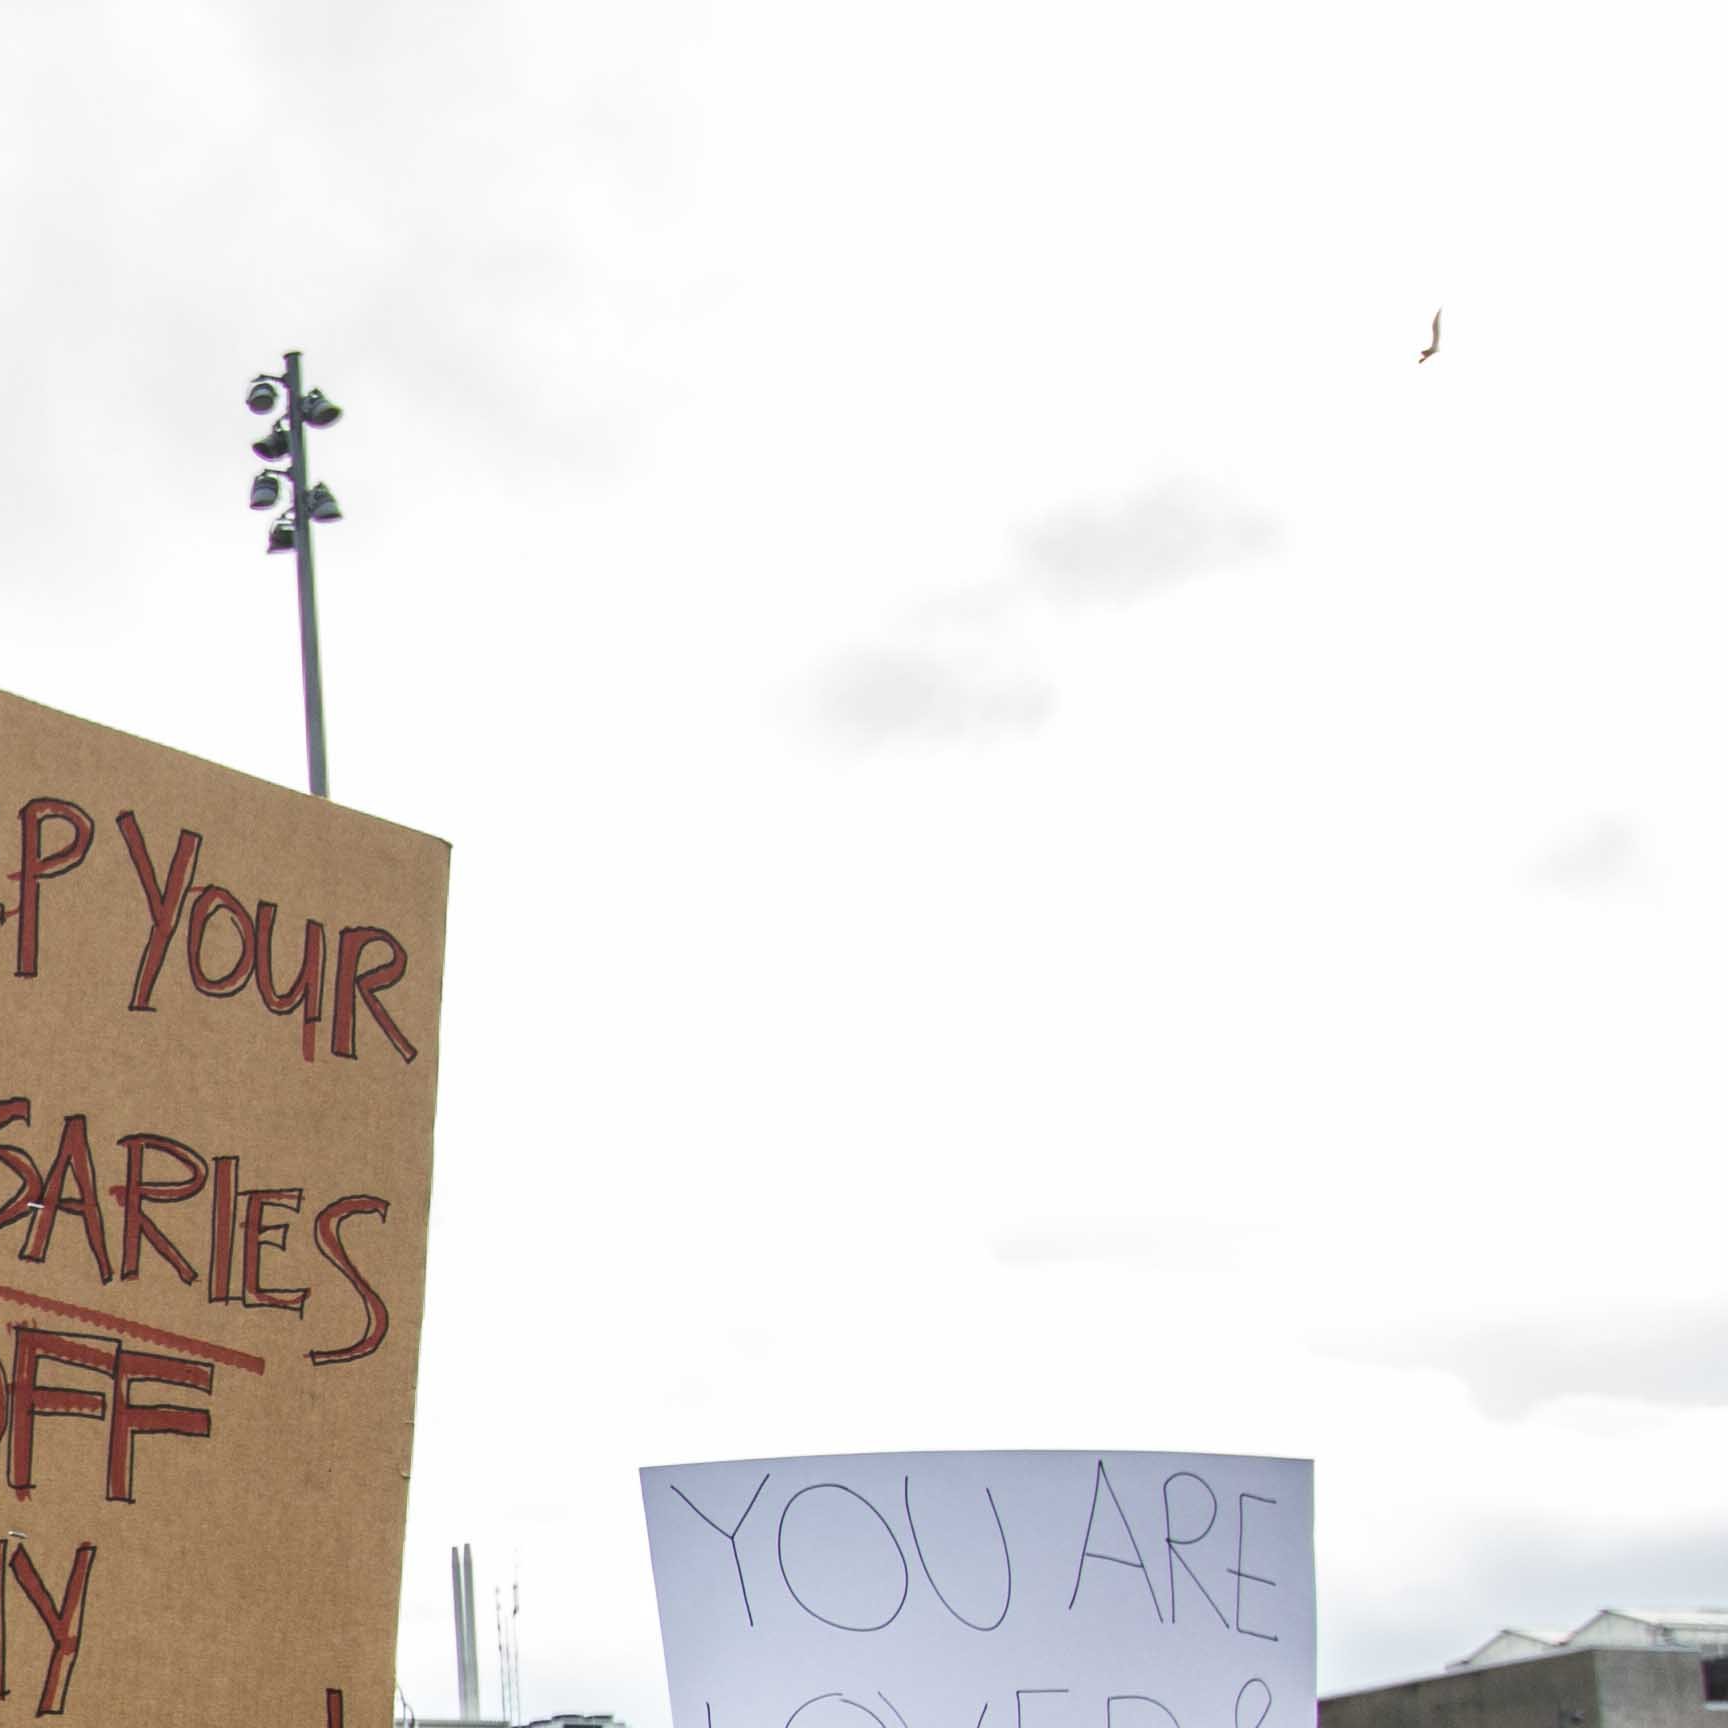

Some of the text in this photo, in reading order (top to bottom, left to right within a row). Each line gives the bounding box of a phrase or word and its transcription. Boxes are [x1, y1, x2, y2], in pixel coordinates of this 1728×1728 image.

[116, 810, 417, 1064] YOUR
[670, 1459, 1279, 1642] YOU ARE
